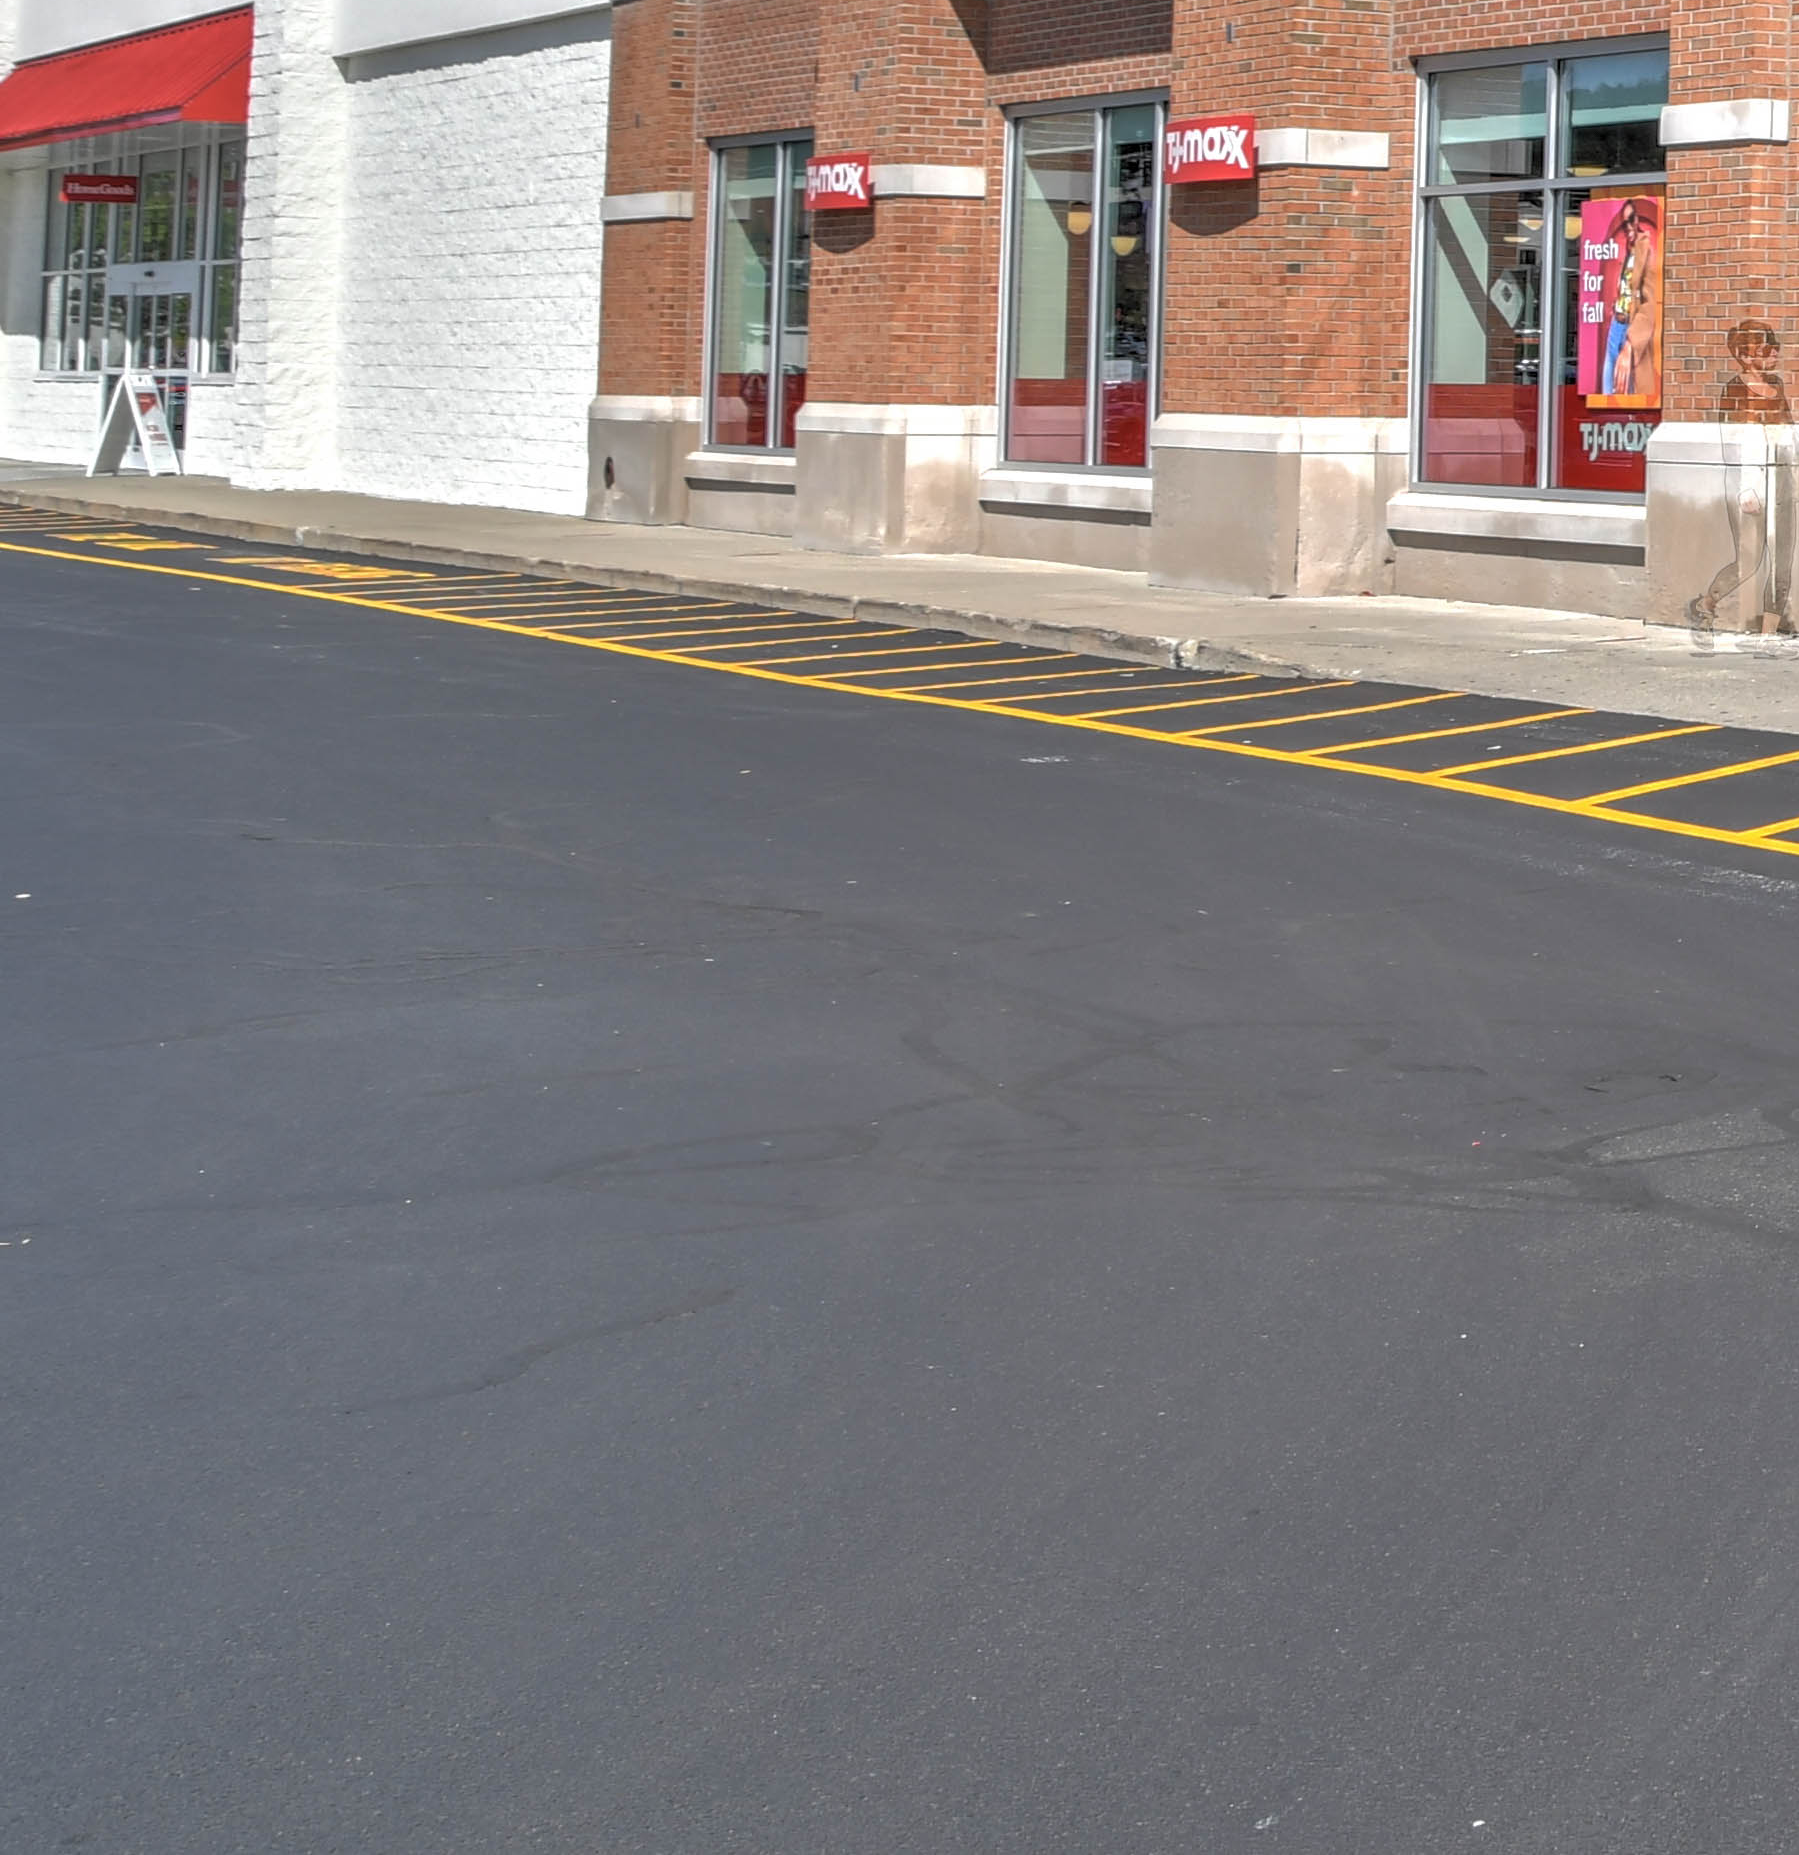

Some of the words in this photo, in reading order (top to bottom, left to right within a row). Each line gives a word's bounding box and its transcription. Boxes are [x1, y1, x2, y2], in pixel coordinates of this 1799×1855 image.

[1584, 238, 1619, 261] fresh
[1583, 271, 1604, 292] for
[1582, 301, 1605, 323] fall
